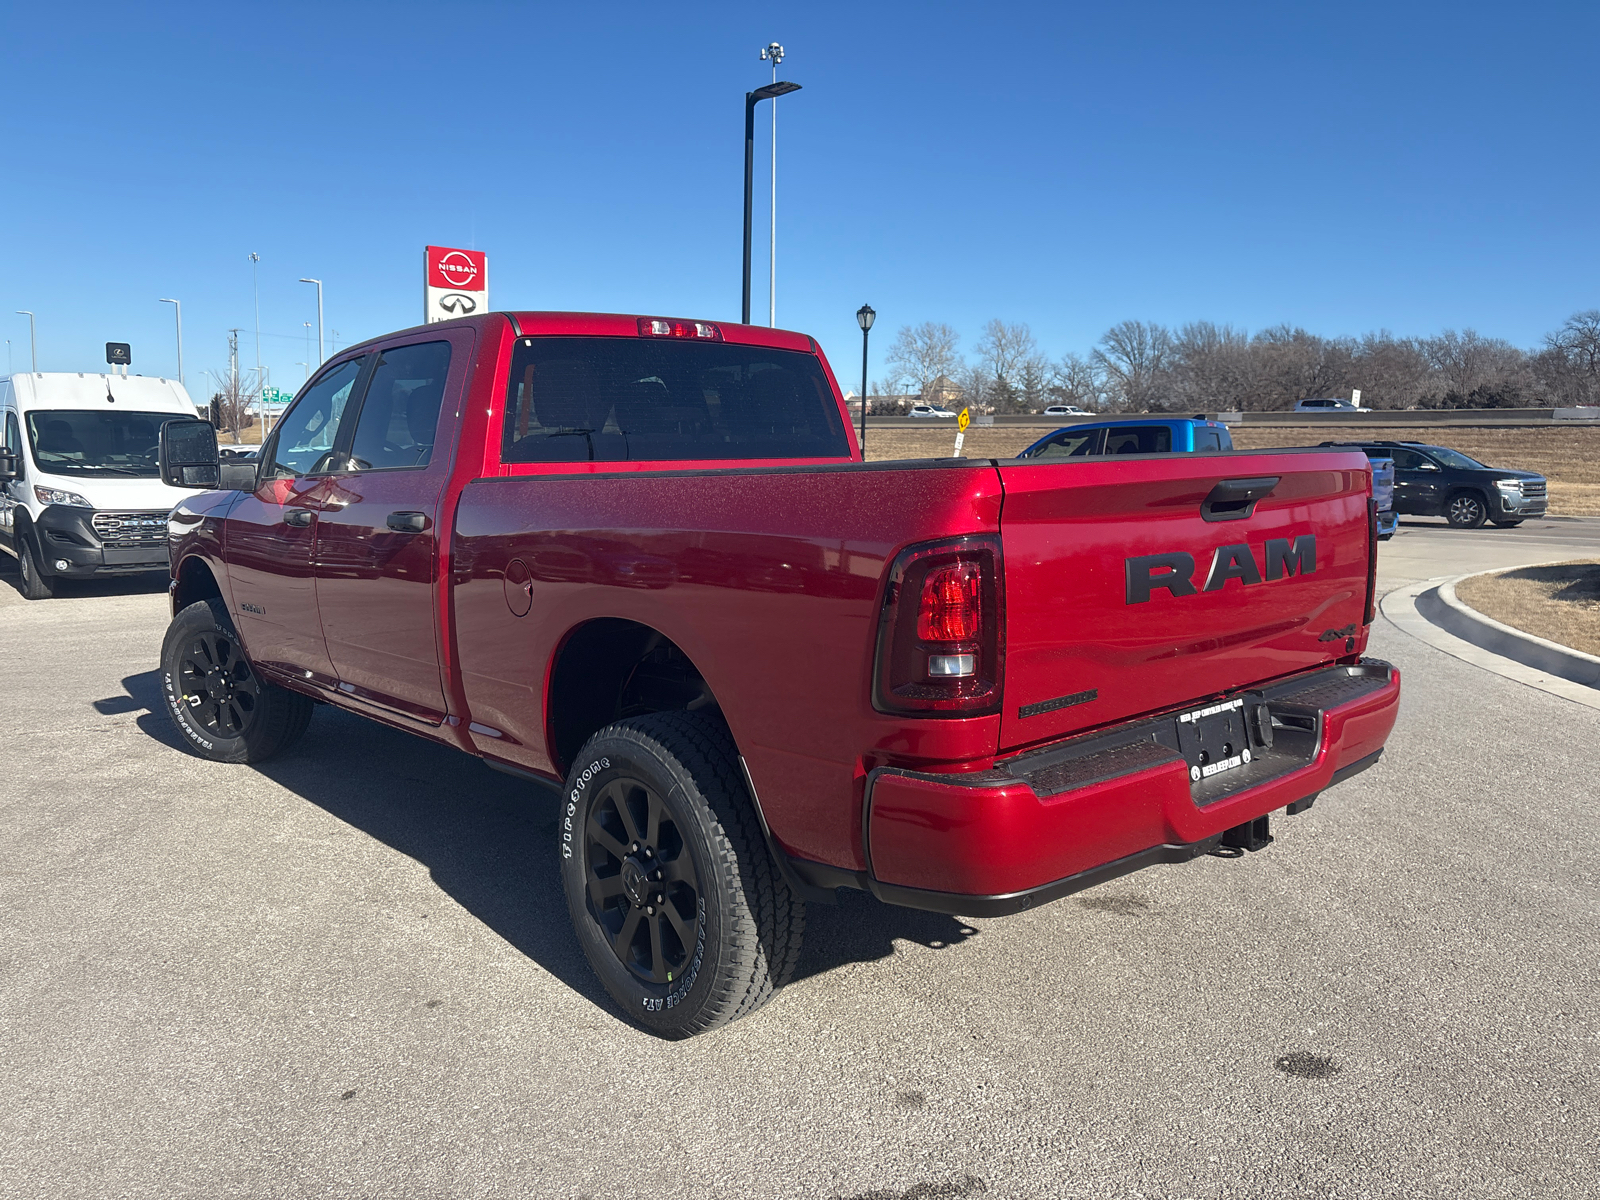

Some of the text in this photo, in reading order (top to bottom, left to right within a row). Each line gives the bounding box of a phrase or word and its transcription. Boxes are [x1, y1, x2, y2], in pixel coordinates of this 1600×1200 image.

[438, 263, 477, 274] NISSAN
[1125, 534, 1316, 605] RAM
[562, 757, 611, 859] Firestone
[667, 897, 706, 1009] TRANSFORCE
